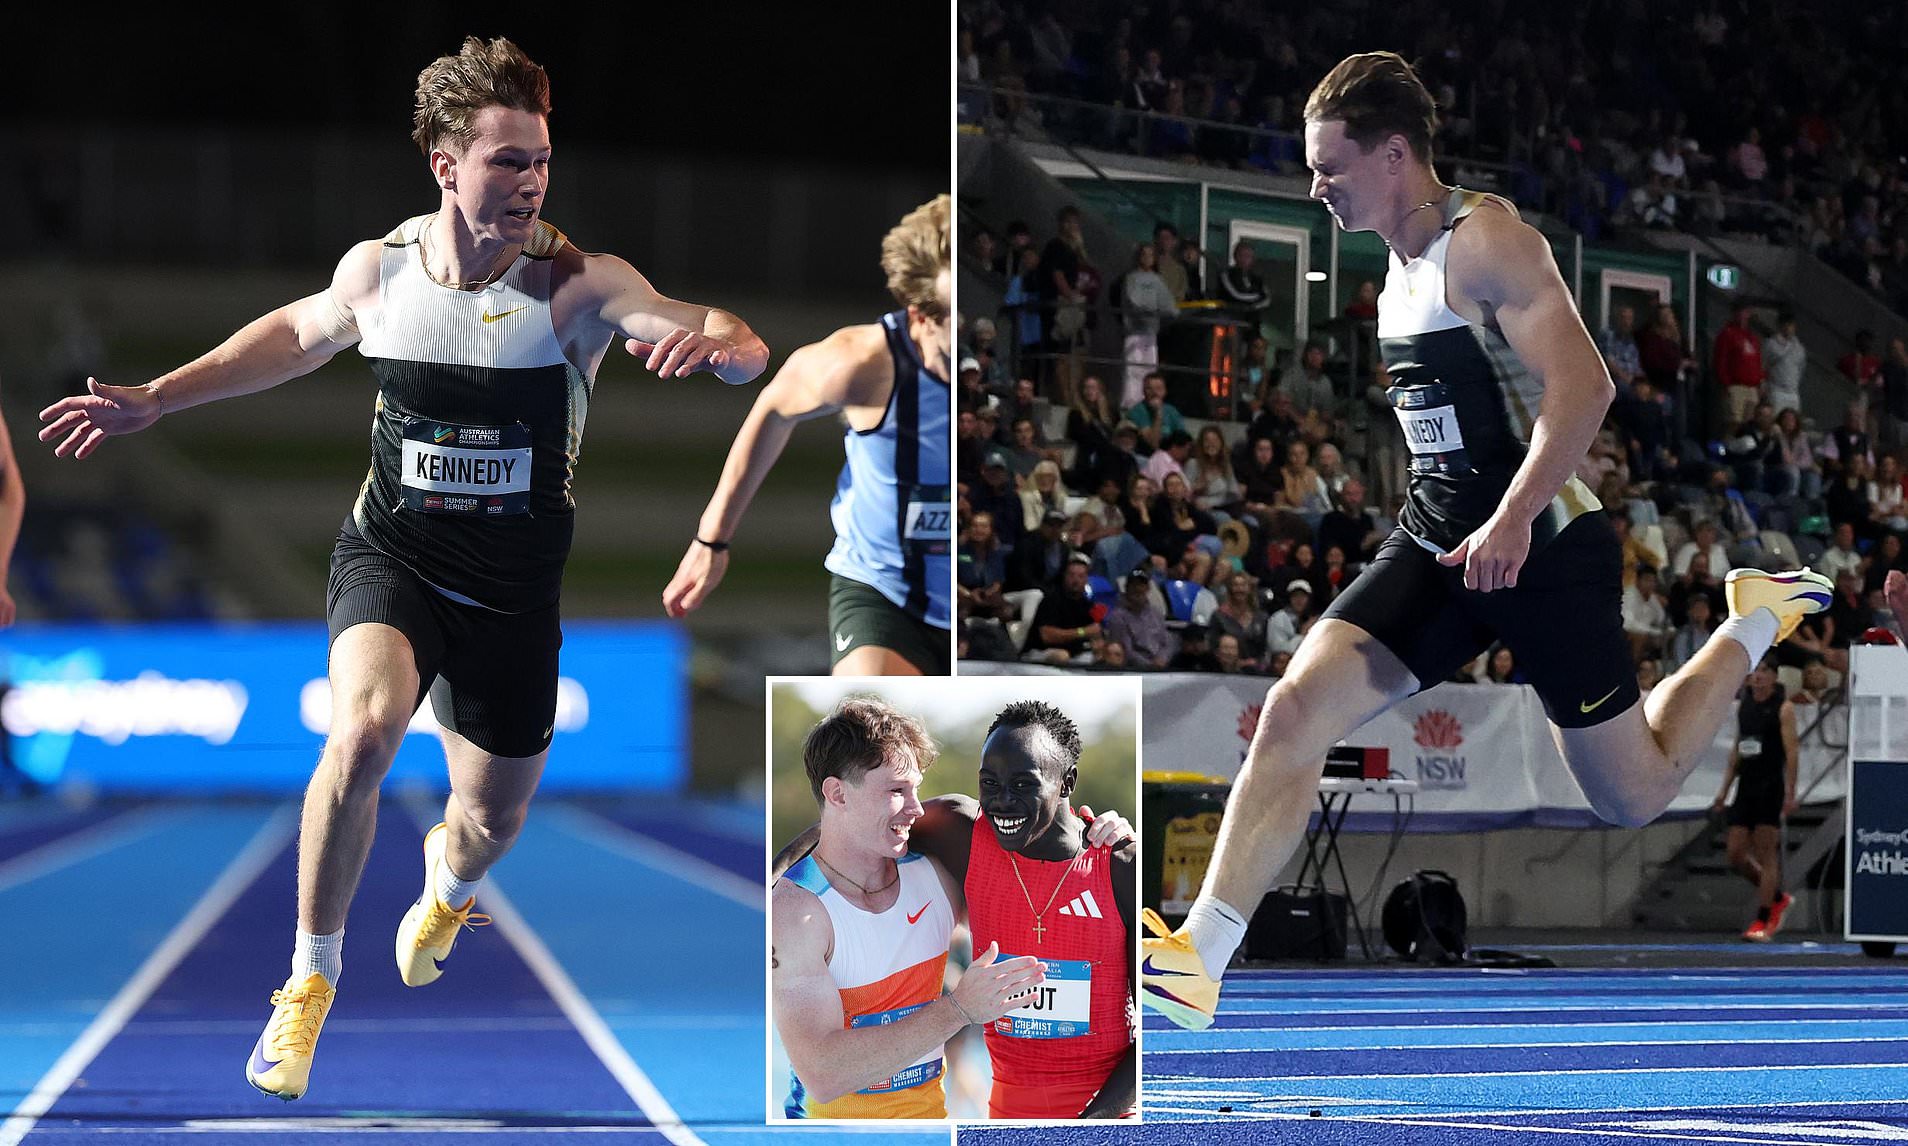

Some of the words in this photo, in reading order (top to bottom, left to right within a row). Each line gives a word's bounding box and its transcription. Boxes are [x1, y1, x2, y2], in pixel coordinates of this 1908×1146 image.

[1408, 416, 1445, 444] NEDY
[416, 451, 517, 485] KENNEDY
[444, 497, 478, 506] SUMMER
[444, 503, 469, 511] SERIES
[913, 511, 949, 531] AZZ
[1416, 756, 1466, 780] NSW
[1015, 1020, 1052, 1031] CHEMIST
[893, 1067, 922, 1083] CHEMIST
